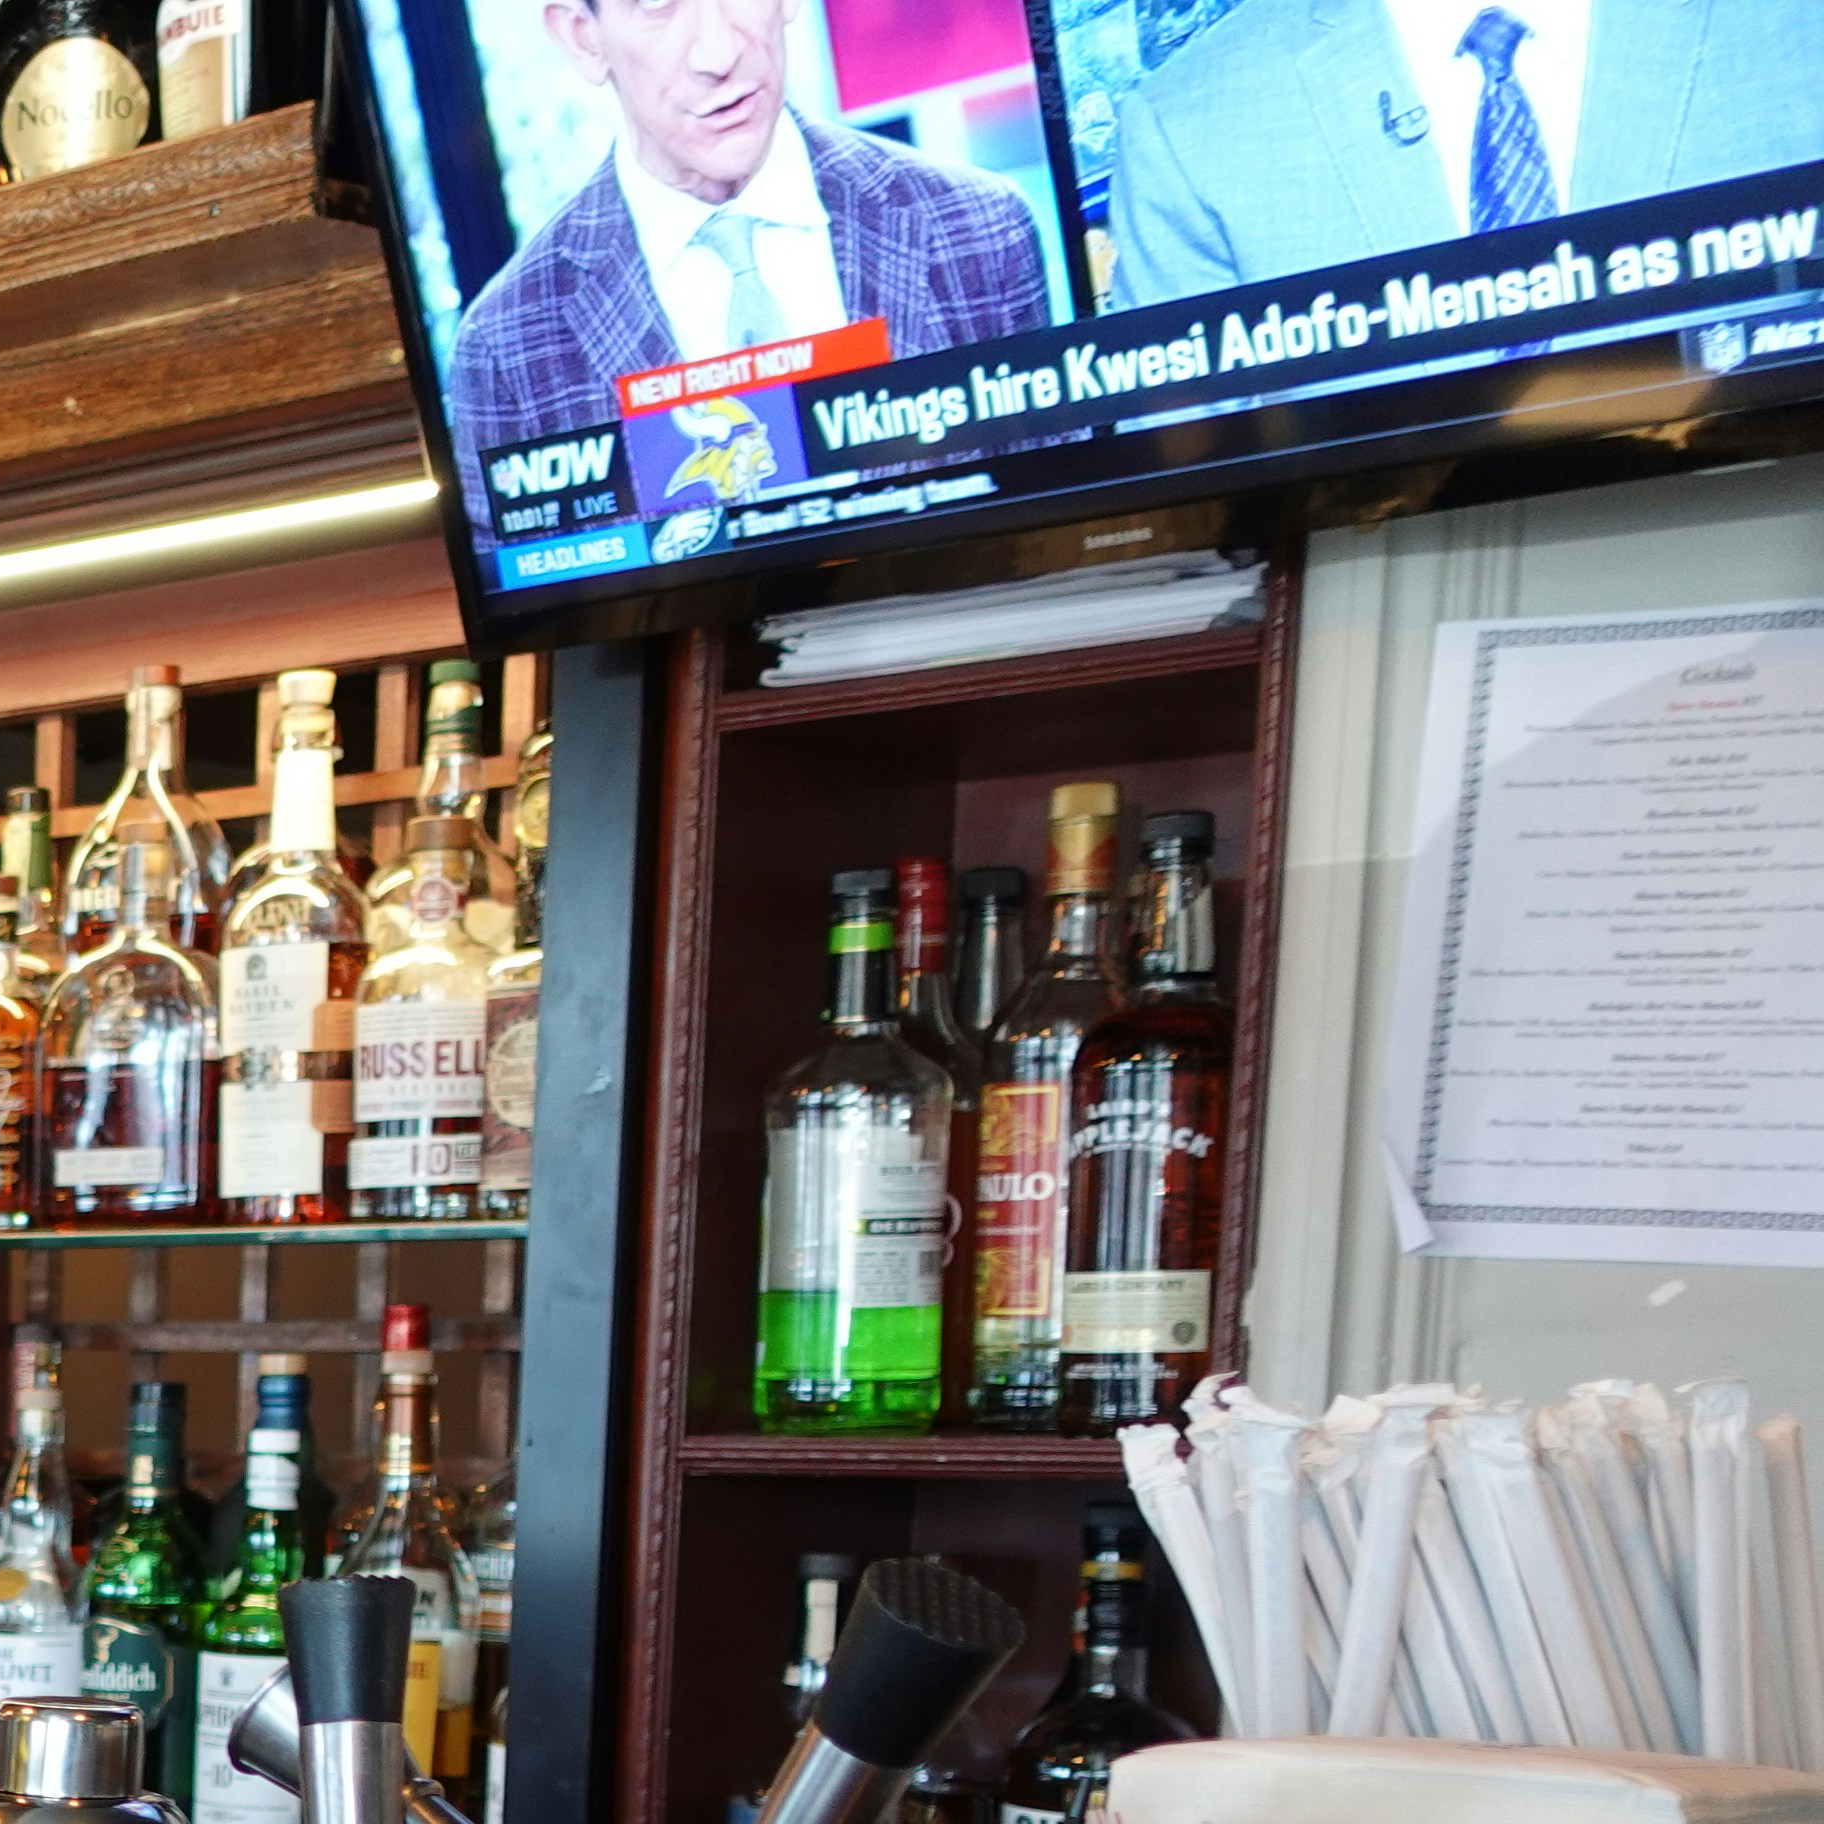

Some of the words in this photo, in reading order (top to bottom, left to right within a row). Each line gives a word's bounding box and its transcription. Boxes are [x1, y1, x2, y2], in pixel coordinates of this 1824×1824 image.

[160, 4, 225, 46] MBUIE
[813, 384, 969, 451] Vikings
[969, 362, 1061, 421] hire
[1063, 322, 1210, 407] Kwesi
[1218, 240, 1598, 372] Adofo-Mensah
[1608, 235, 1679, 295] as
[1689, 206, 1821, 280] new
[628, 375, 683, 407] NEW
[686, 361, 752, 395] RIGHT
[752, 342, 814, 379] NOW
[506, 433, 616, 499] NOW
[572, 492, 619, 520] LIVE
[515, 536, 628, 577] HEADLINES
